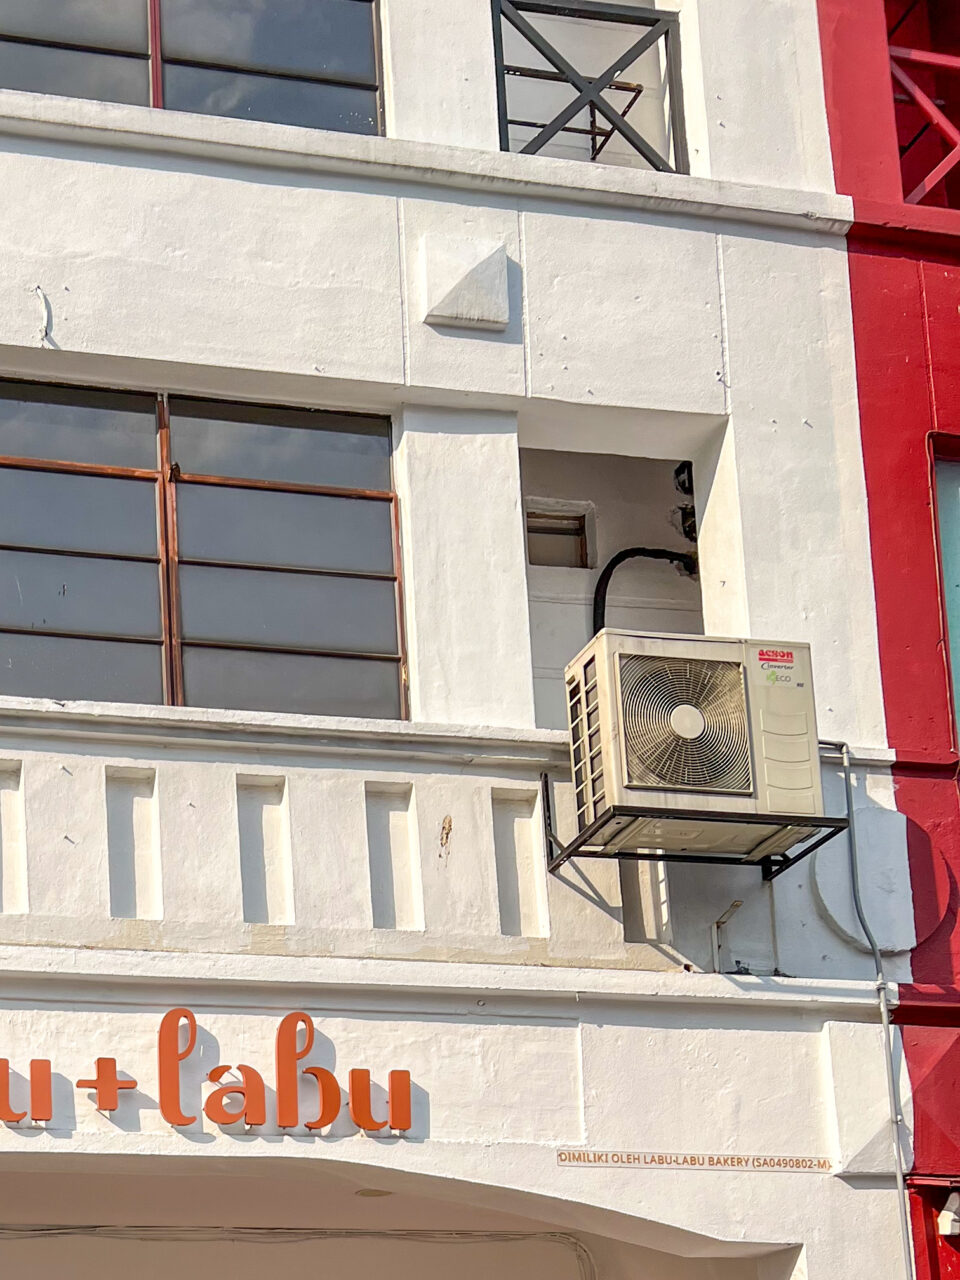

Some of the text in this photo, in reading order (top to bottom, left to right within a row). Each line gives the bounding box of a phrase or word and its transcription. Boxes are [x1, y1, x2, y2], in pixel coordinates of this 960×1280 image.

[559, 1151, 609, 1164] DIMILIKI
[611, 1153, 641, 1165] OLEH
[708, 1156, 750, 1168] BAKERY
